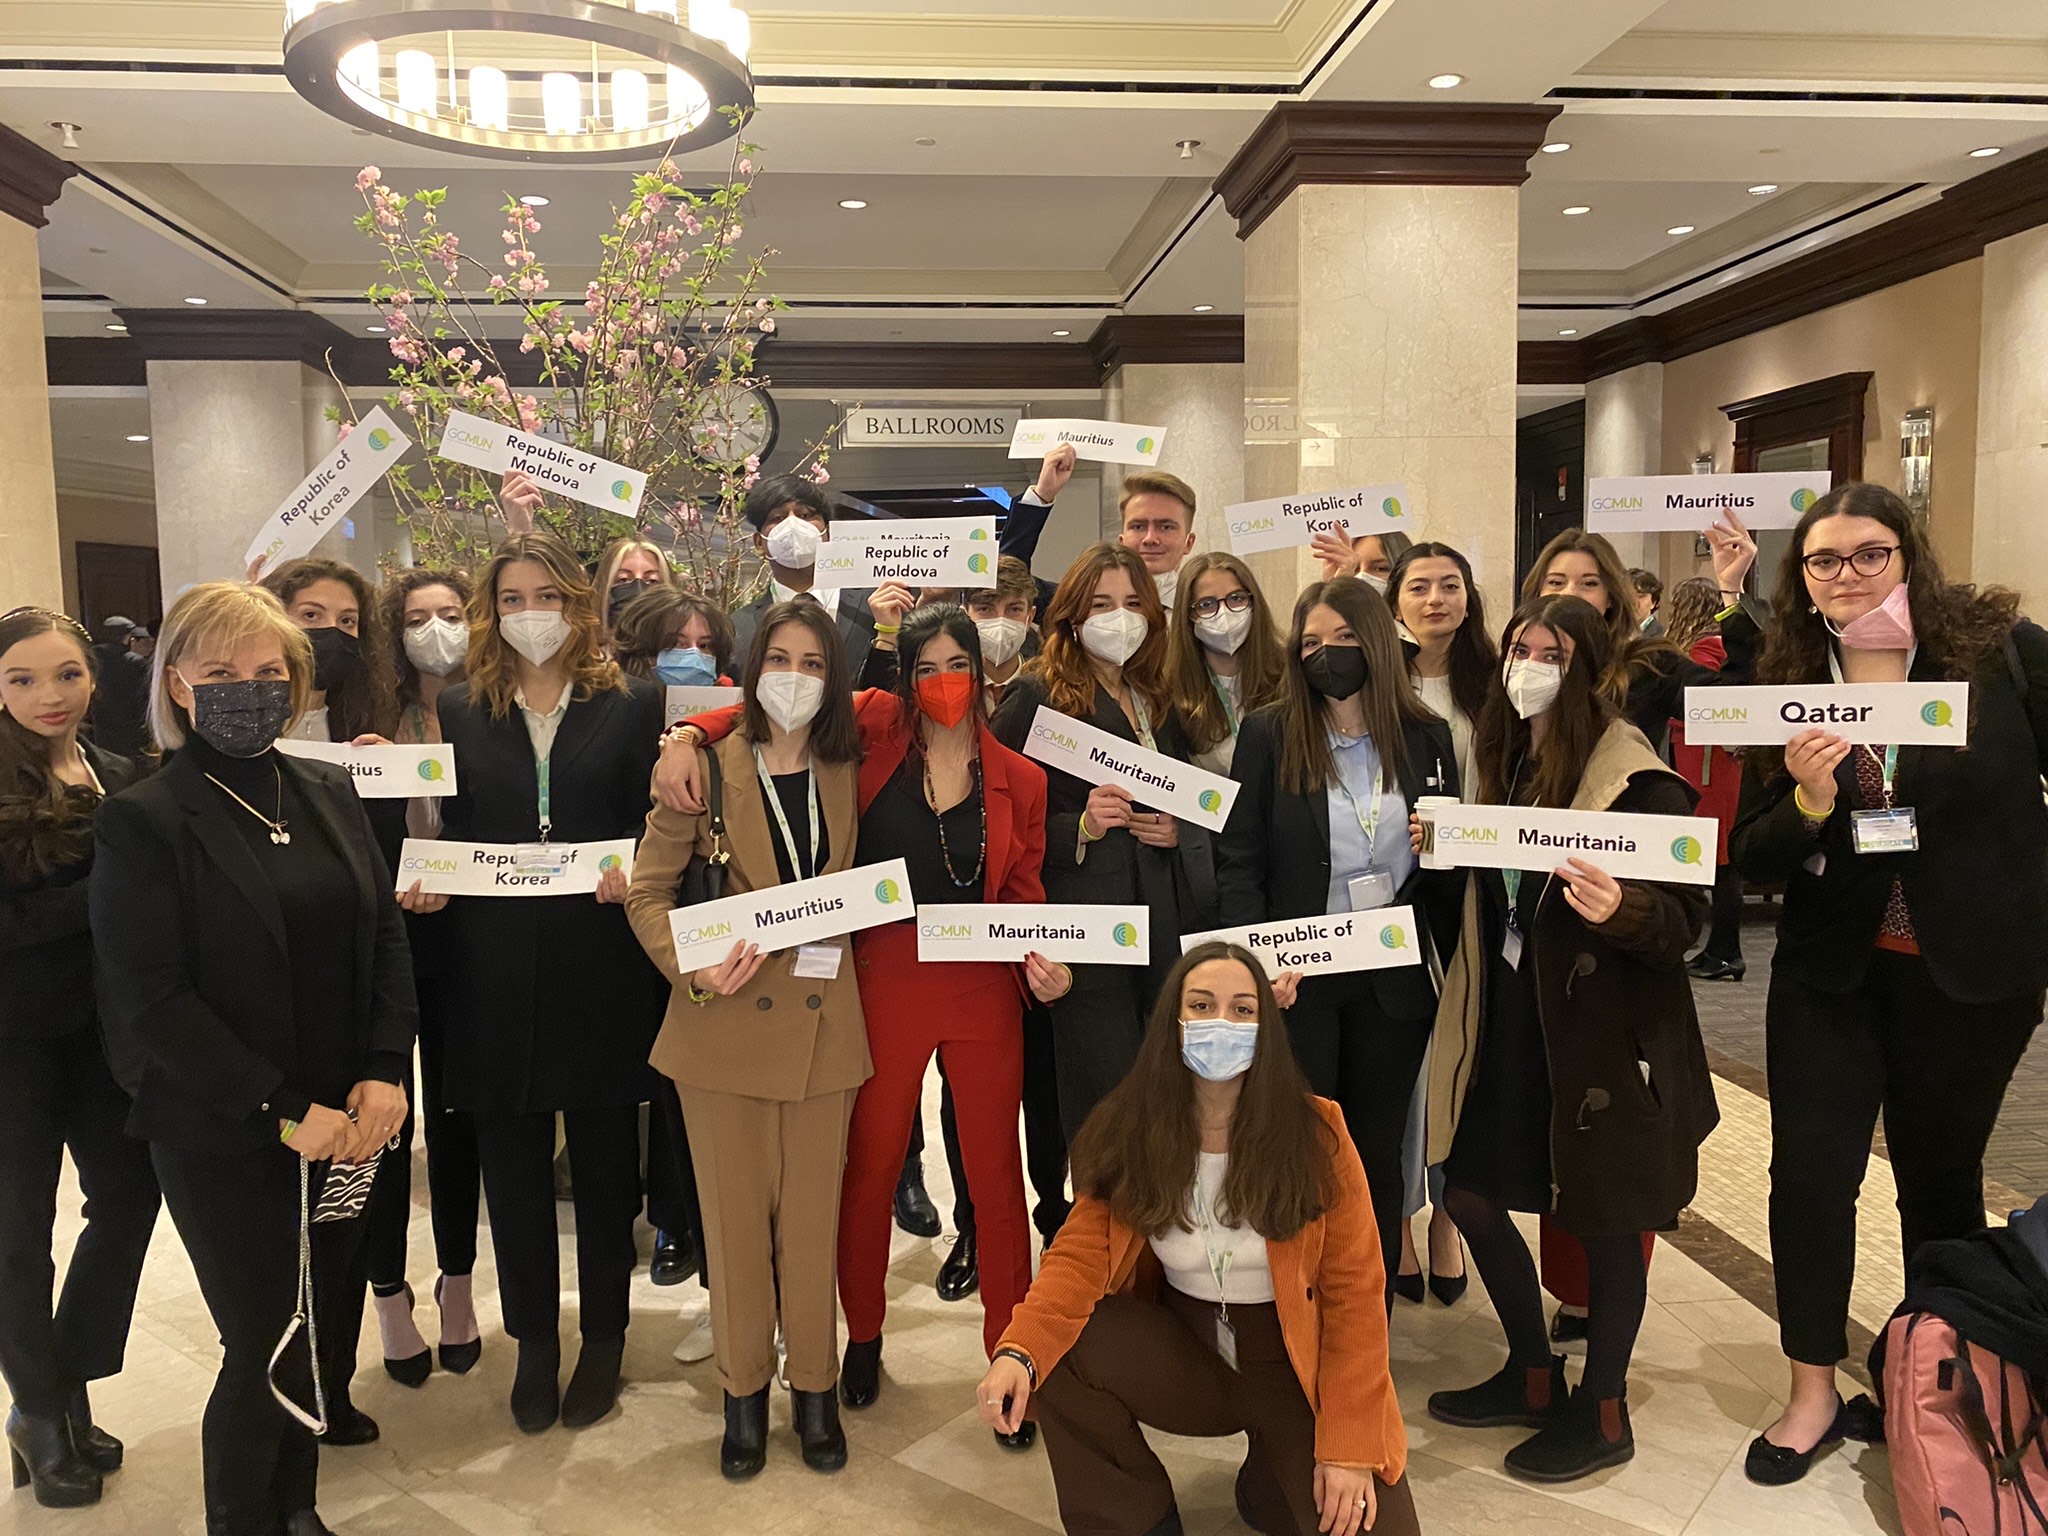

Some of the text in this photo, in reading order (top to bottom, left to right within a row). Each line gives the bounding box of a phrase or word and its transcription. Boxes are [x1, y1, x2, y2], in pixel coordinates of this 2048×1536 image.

[866, 417, 1004, 435] BALLROOMS
[447, 427, 494, 449] GCMUN
[1057, 431, 1115, 447] Mauritius
[506, 434, 575, 468] Republic
[578, 462, 597, 475] of
[510, 455, 580, 490] Moldova
[280, 469, 336, 526] Republic
[336, 449, 351, 471] of
[309, 485, 351, 526] Korea
[1282, 493, 1363, 516] Republic of
[1592, 498, 1643, 510] GCMUN
[1665, 494, 1755, 509] Mauritius
[1231, 518, 1274, 534] GCMUN
[1306, 519, 1349, 532] Kora
[865, 545, 949, 561] Republic of
[816, 558, 854, 569] GCMUN
[873, 565, 937, 577] Moldova
[1688, 708, 1747, 721] GCMUN
[1780, 701, 1873, 722] Qatar
[1033, 724, 1077, 748] GCMUN
[1089, 747, 1175, 792] Mauritania
[1438, 826, 1498, 842] GCMUN
[1518, 828, 1637, 852] Mauritania
[403, 857, 457, 871] GCMUN
[561, 850, 578, 864] of
[495, 872, 550, 885] Korea
[754, 897, 844, 928] Mauritius
[677, 921, 732, 945] GCMUN
[921, 924, 973, 937] GCMUN
[988, 923, 1086, 940] Mauritania
[1249, 920, 1353, 948] Republic of
[1276, 951, 1332, 967] Korea
